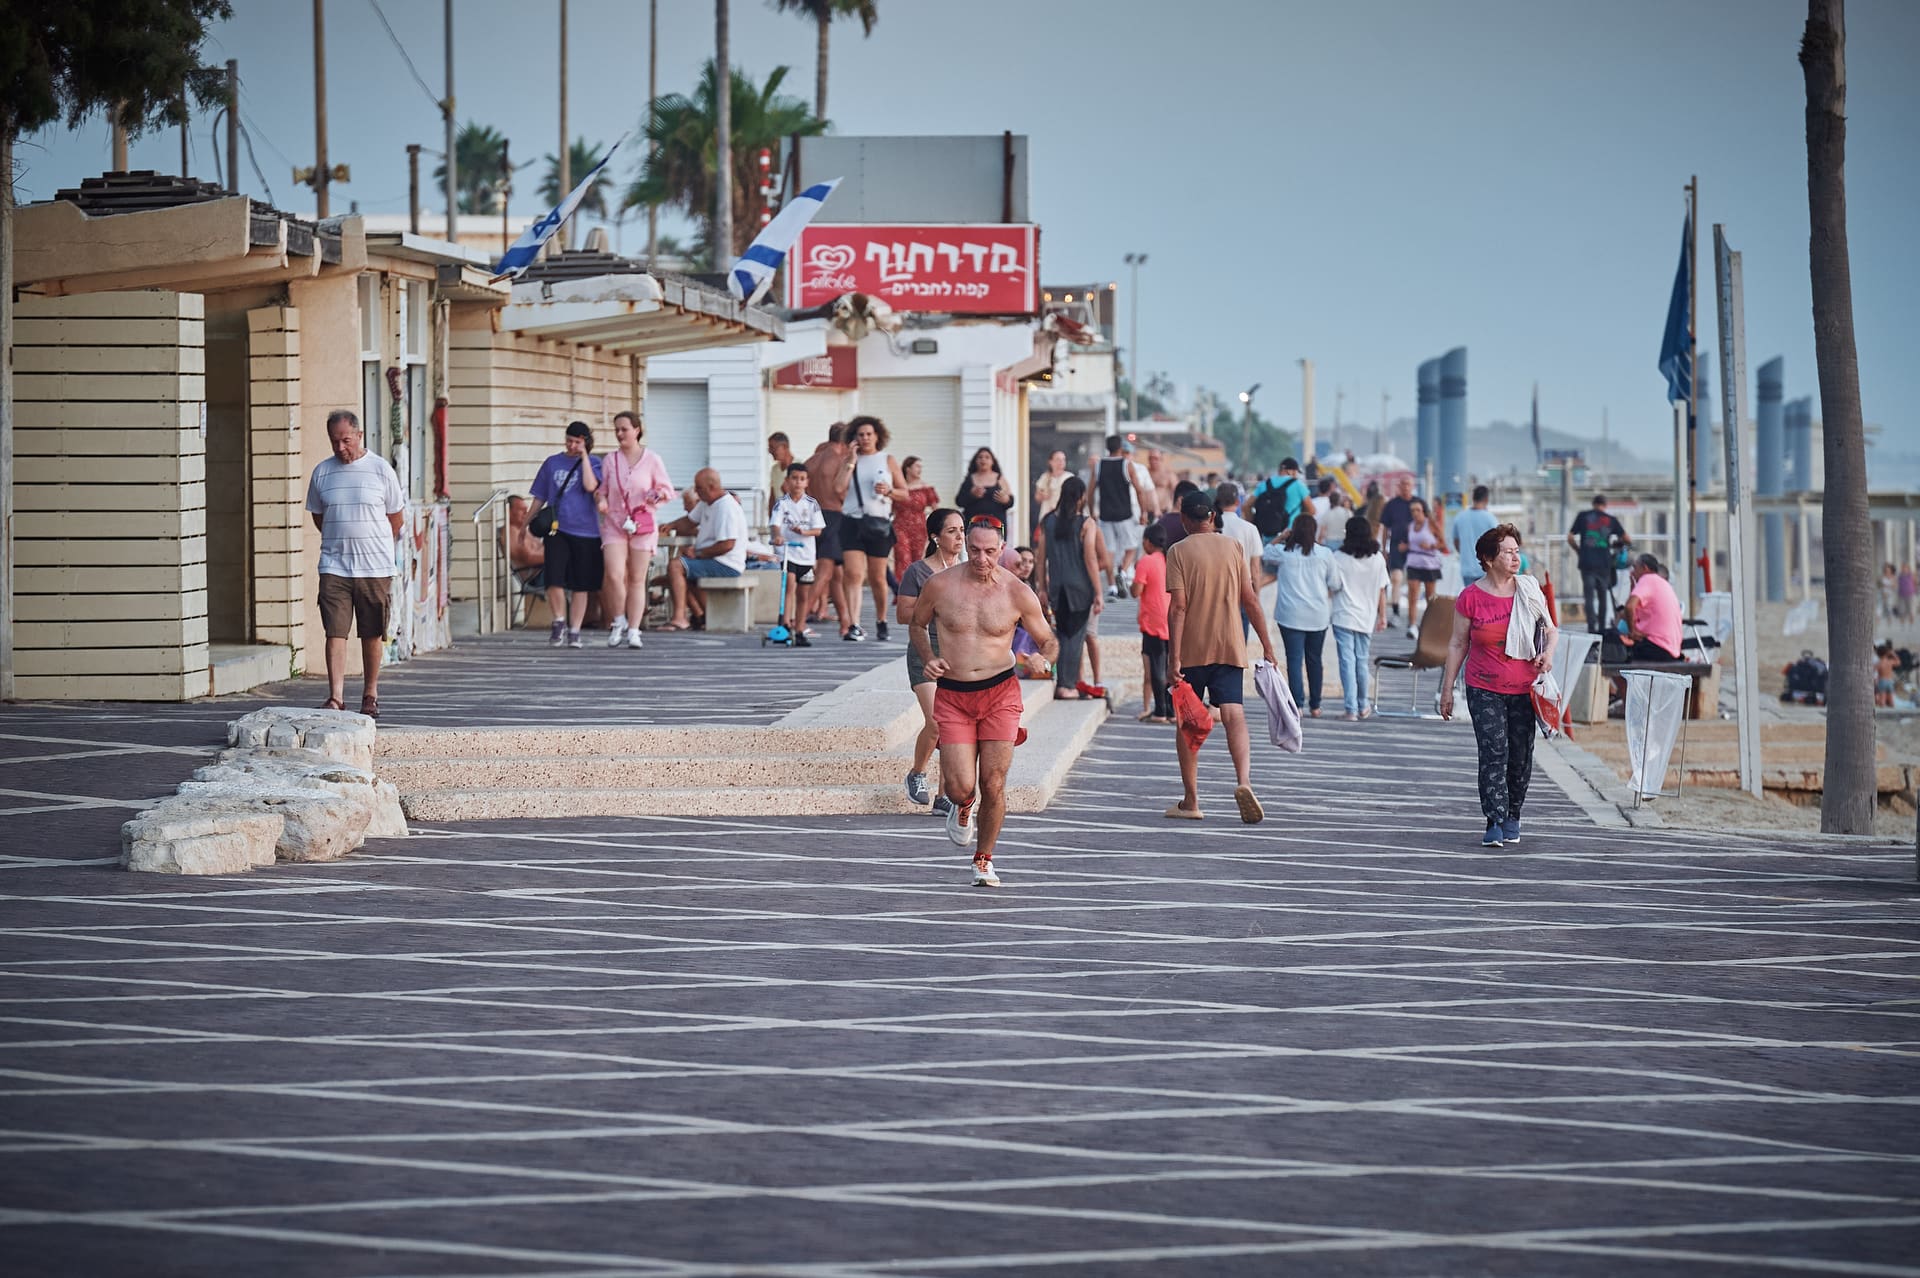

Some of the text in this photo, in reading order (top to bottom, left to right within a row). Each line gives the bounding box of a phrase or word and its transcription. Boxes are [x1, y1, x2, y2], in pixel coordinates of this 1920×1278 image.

[865, 241, 1020, 282] מדרחוף
[891, 281, 990, 299] קפה לחברים
